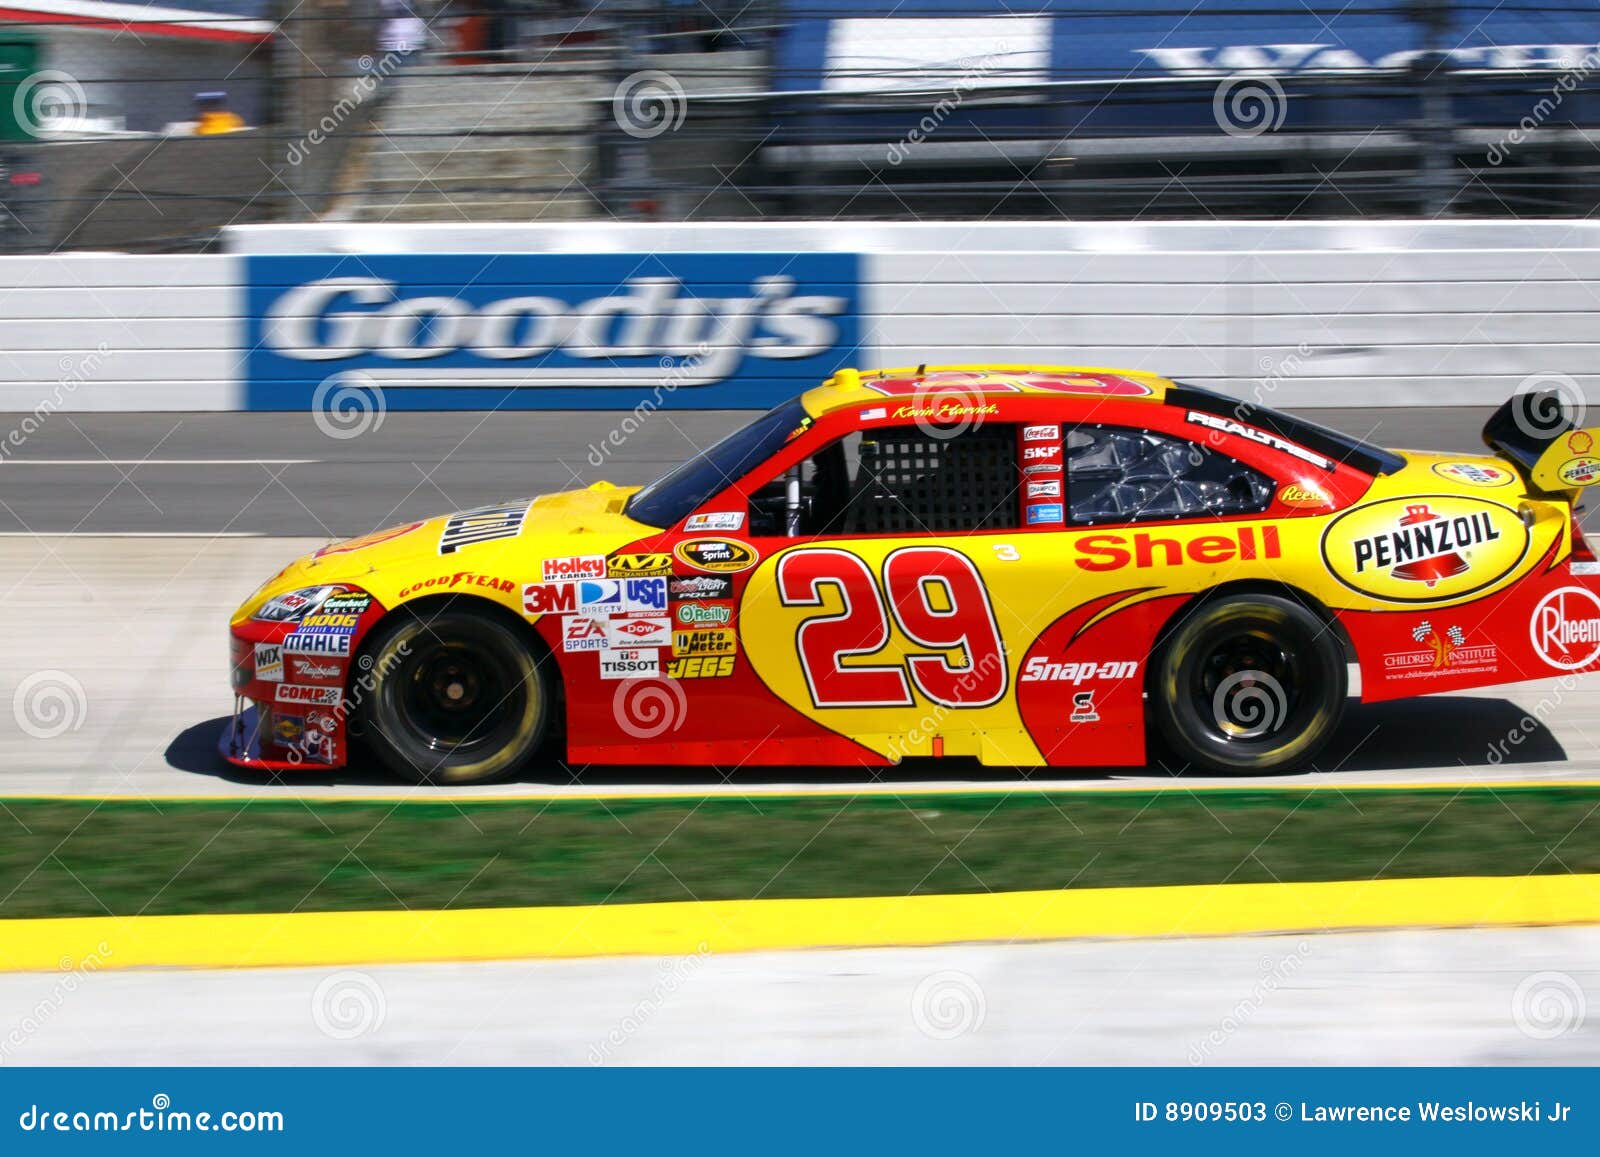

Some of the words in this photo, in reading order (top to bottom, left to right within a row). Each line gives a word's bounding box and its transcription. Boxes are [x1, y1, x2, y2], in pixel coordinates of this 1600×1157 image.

[262, 275, 848, 387] Goody's
[892, 406, 935, 418] Kevin
[992, 543, 1020, 561] 3
[1074, 525, 1281, 571] Shell
[1354, 511, 1499, 573] PENNZOIL
[702, 551, 731, 560] Sprint
[543, 558, 604, 577] Holley
[399, 571, 516, 598] GOODYEAR
[627, 578, 666, 609] USG
[524, 583, 576, 613] 3M
[301, 614, 358, 627] MOOG
[679, 604, 731, 624] O'Reilly
[1542, 593, 1600, 654] Rheem
[567, 618, 606, 639] EA
[691, 632, 725, 642] Auto
[774, 546, 1009, 709] 29
[283, 635, 348, 652] MAHLE
[566, 639, 609, 649] SPORTS
[689, 641, 733, 653] Meter
[255, 646, 281, 667] WIX
[602, 661, 658, 672] TISSOT
[1384, 650, 1435, 667] CHILDRESS
[1448, 647, 1497, 661] INSTITUTE
[667, 656, 736, 679] JEGS
[1021, 656, 1138, 686] Snap-on
[278, 685, 325, 699] COMP
